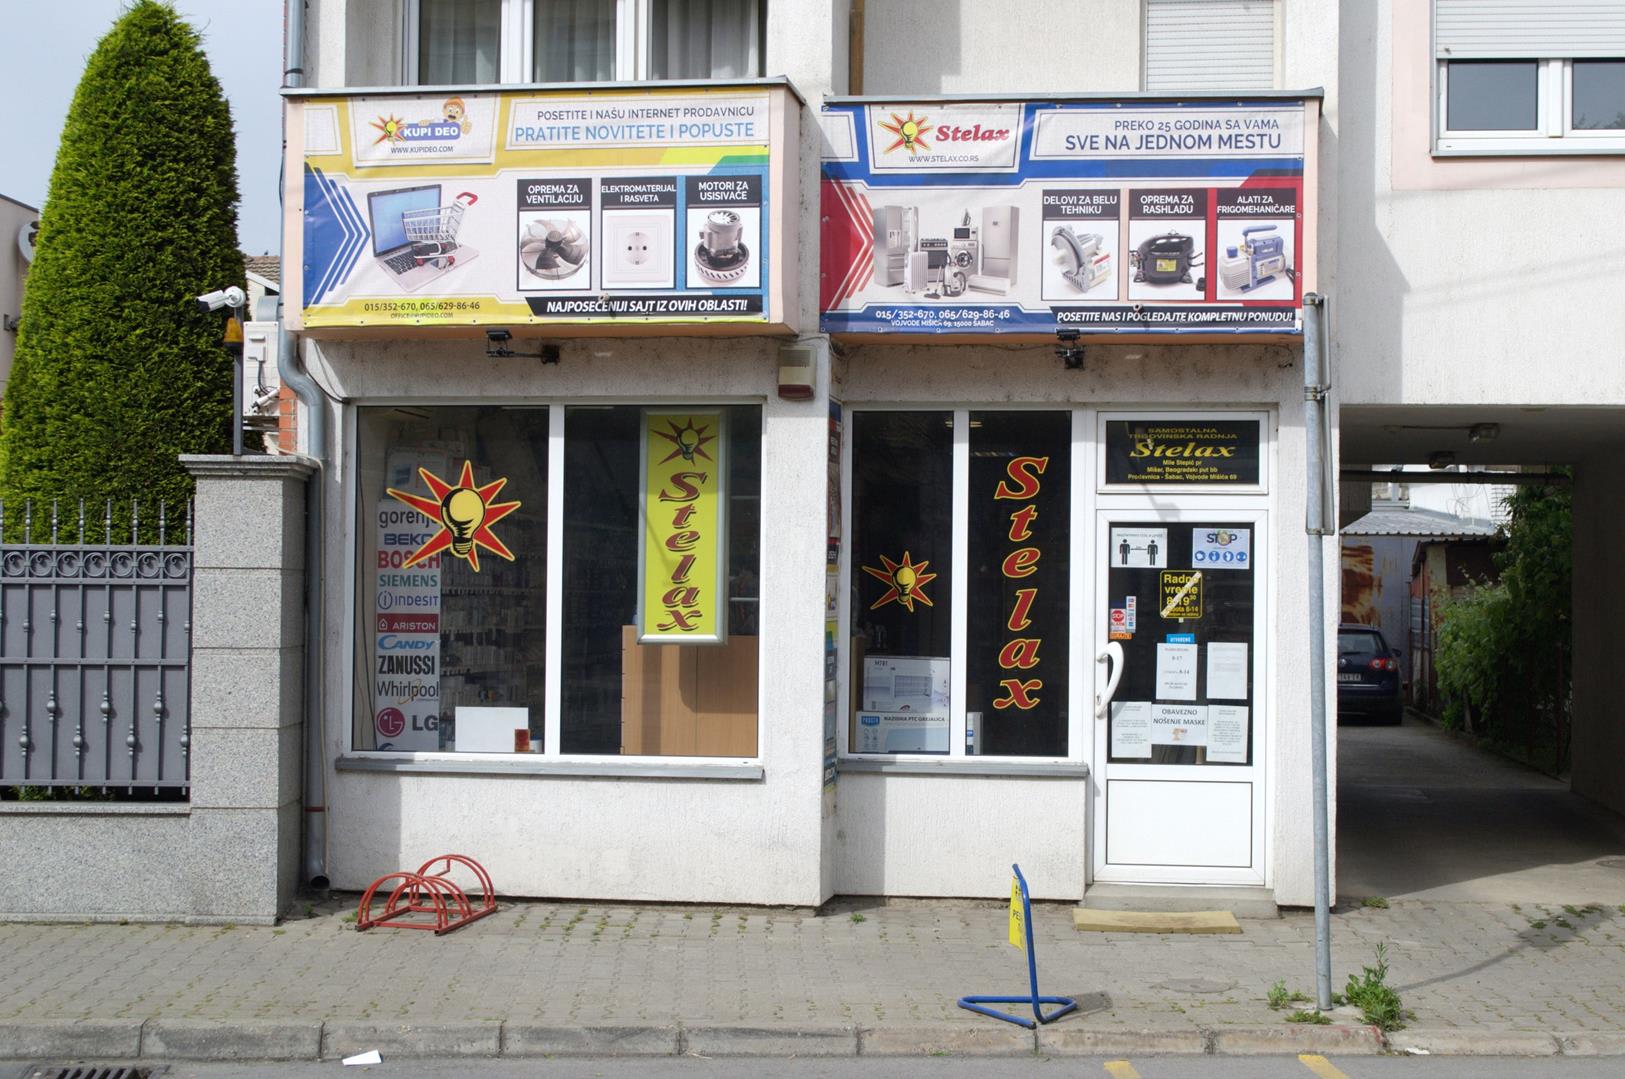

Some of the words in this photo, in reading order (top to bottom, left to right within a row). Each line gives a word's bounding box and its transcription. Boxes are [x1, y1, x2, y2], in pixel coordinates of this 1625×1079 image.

[537, 109, 587, 120] POSETITE
[596, 107, 625, 119] NAŠU
[628, 107, 680, 119] INTERNET
[683, 106, 754, 117] PRODAVNICU
[1115, 120, 1154, 130] PREKO
[1158, 121, 1171, 132] 25
[1174, 120, 1222, 130] GODINA
[1225, 120, 1241, 129] SA
[1243, 119, 1279, 129] VAMA
[403, 127, 432, 137] KUPI
[435, 126, 459, 136] DEO
[515, 126, 580, 141] PRATITE
[585, 124, 665, 139] NOVITETE
[670, 124, 673, 138] I
[679, 122, 754, 137] POPUSTE
[935, 124, 1010, 142] Stelax
[1065, 135, 1100, 150] SVE
[1105, 135, 1130, 150] NA
[1135, 134, 1212, 150] JEDNOM
[1218, 133, 1281, 149] MESTU
[391, 145, 453, 154] WWW.KUPIDEO.COM
[908, 155, 979, 163] WWW.STELAX.CO.RS
[528, 185, 565, 194] OPREMA
[566, 185, 579, 193] ZA
[601, 184, 677, 193] ELEKTROMATERIJAL
[698, 182, 735, 191] MOTORI
[736, 181, 749, 190] ZA
[526, 194, 583, 204] VENTILACIJU
[624, 194, 659, 202] RASVETA
[699, 189, 748, 201] USISIVAČE
[1043, 196, 1077, 205] DELOVI
[1078, 196, 1092, 205] ZA
[1093, 195, 1117, 204] BELU
[1140, 195, 1179, 205] OPREMA
[1181, 195, 1194, 204] ZA
[1237, 196, 1261, 204] ALATI
[1261, 196, 1274, 204] ZA
[1060, 205, 1102, 214] TEHNIKU
[1142, 204, 1194, 214] RASHLADU
[1217, 203, 1296, 214] FRIGOMEHANIČARE
[364, 302, 418, 312] 015/352-670,
[420, 301, 480, 311] 065/629-86-46
[628, 300, 656, 312] SAJT
[656, 300, 667, 311] IZ
[668, 300, 697, 311] OVIH
[698, 299, 748, 311] OBLASTI!
[875, 309, 937, 320] 015/352-670,
[938, 309, 1010, 320] 065/629-86-46
[1056, 312, 1101, 322] POSETITE
[1101, 311, 1122, 321] NAS
[1127, 311, 1187, 322] POGLEDAJTE
[1187, 311, 1247, 321] KOMPLETNU
[1247, 311, 1293, 321] PONUDU!
[1129, 441, 1236, 457] Stelax
[379, 511, 437, 528] gorenj
[657, 471, 707, 632] Stelax
[377, 550, 440, 569] BOH
[378, 574, 438, 587] SIEMENS
[993, 456, 1049, 710] Stelax
[392, 622, 436, 630] ARISTON
[378, 655, 435, 675] ZANUSSI
[377, 680, 439, 701] Whirlpool
[412, 715, 439, 731] LG
